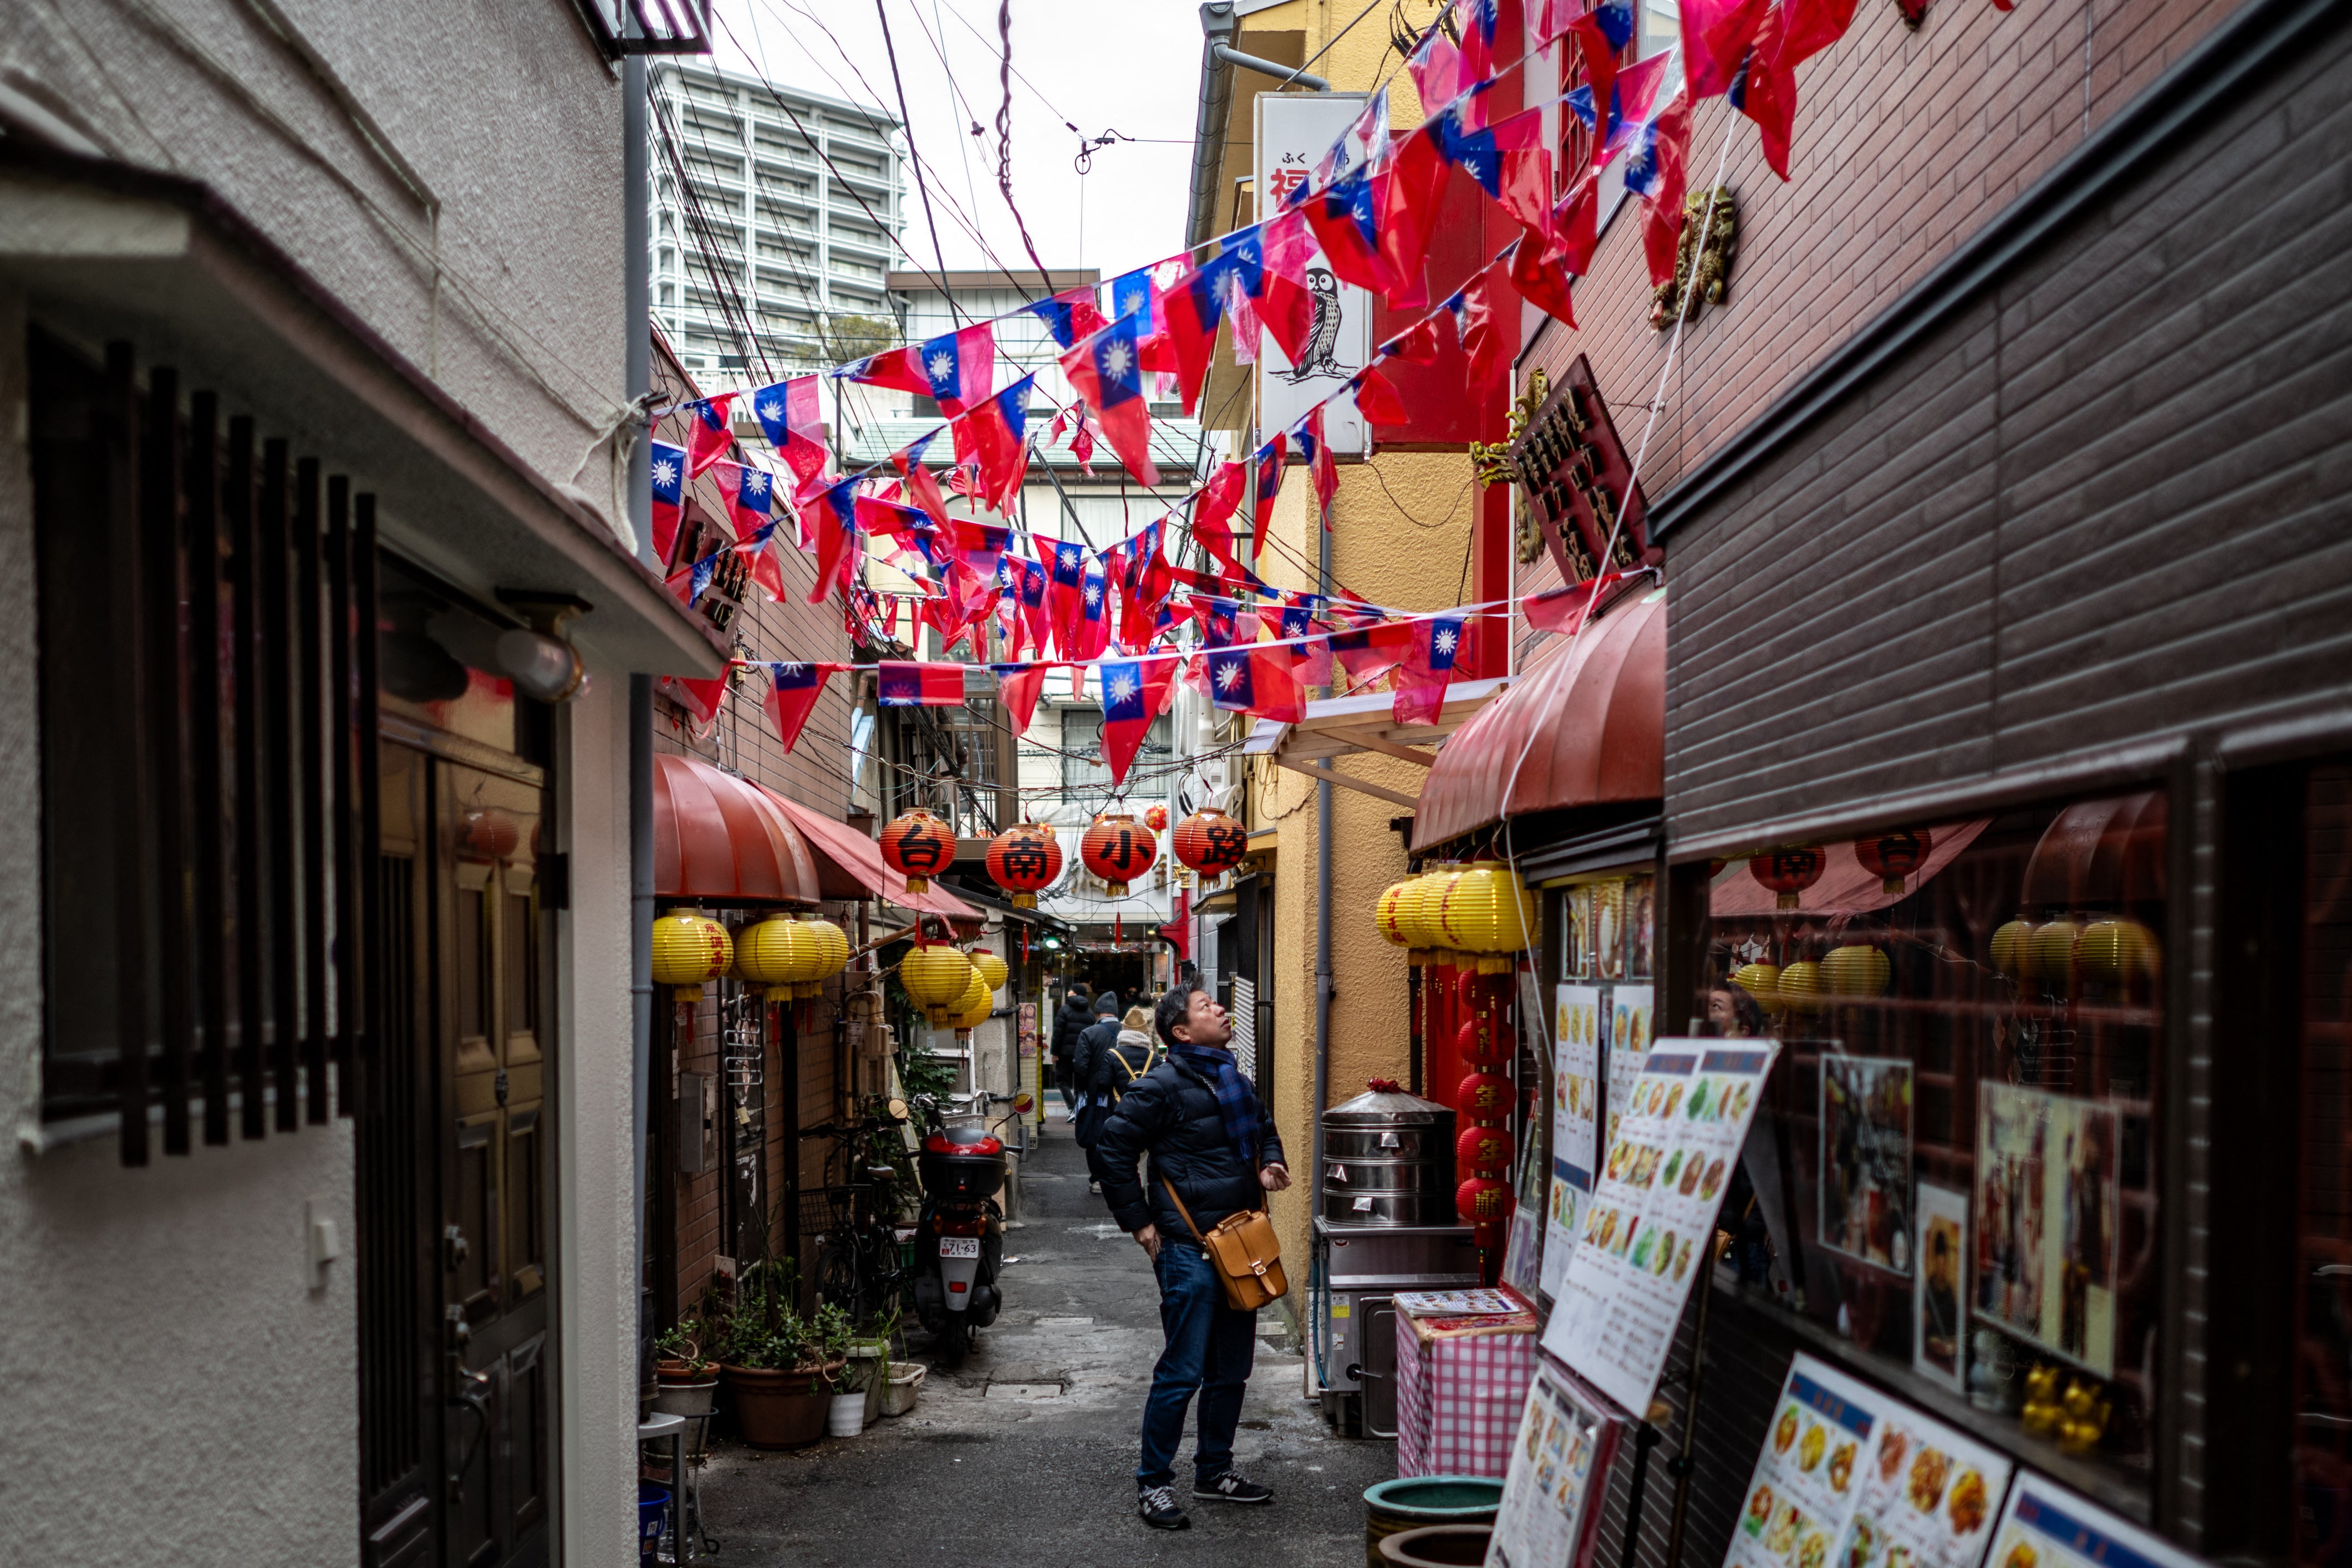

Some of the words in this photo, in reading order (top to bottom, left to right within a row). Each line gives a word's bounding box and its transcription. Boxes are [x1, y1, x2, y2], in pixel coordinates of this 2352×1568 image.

[704, 923, 724, 978] 風調雨順
[949, 1243, 976, 1253] 71-63
[1218, 1478, 1238, 1494] N
